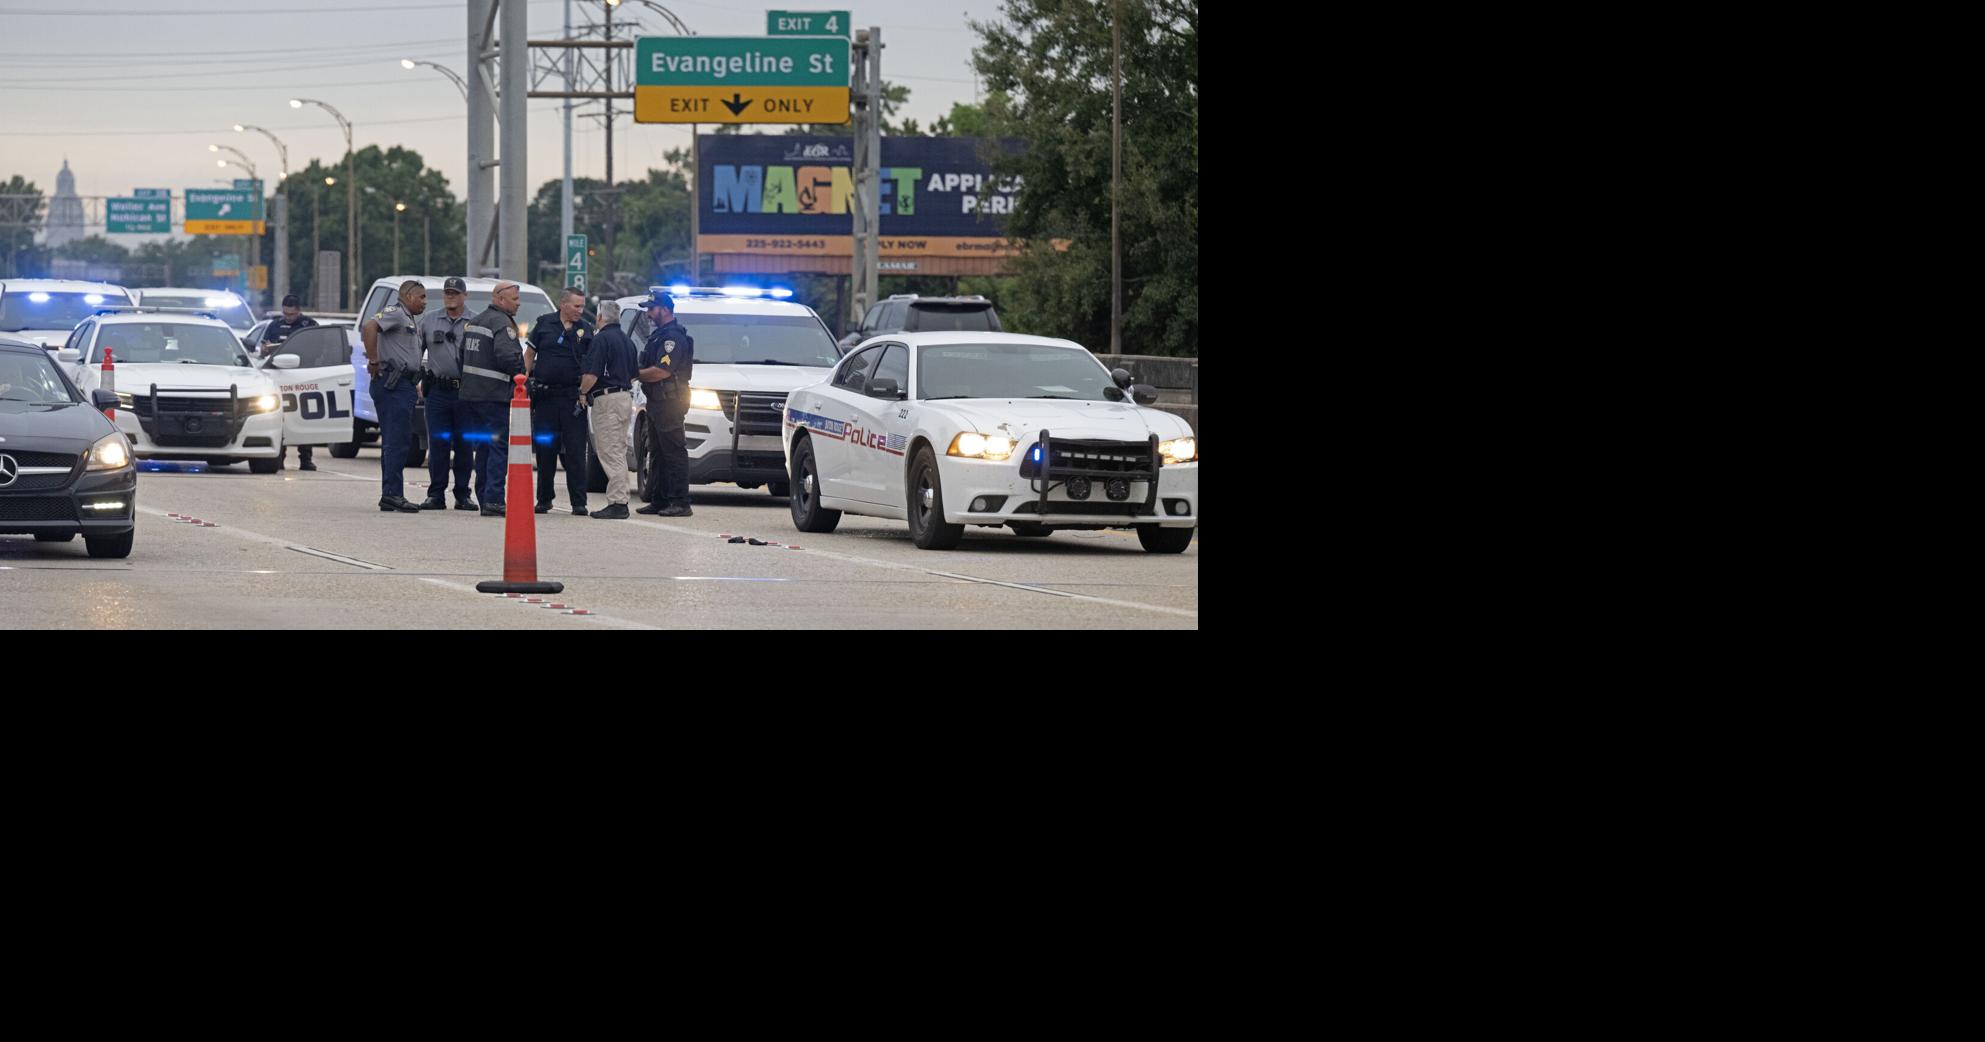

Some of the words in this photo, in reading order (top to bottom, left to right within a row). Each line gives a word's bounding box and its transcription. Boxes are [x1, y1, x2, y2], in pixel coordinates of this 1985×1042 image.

[778, 17, 812, 31] EXIT
[825, 16, 838, 33] 4
[652, 53, 793, 77] Evangeline
[808, 54, 834, 73] St
[670, 98, 709, 113] EXIT
[763, 98, 814, 113] ONLY
[569, 239, 584, 248] MILE
[746, 239, 826, 249] 225-922-5443
[898, 240, 927, 249] NOW
[570, 252, 582, 270] 4
[574, 275, 584, 291] 8
[295, 383, 320, 391] ROUGE
